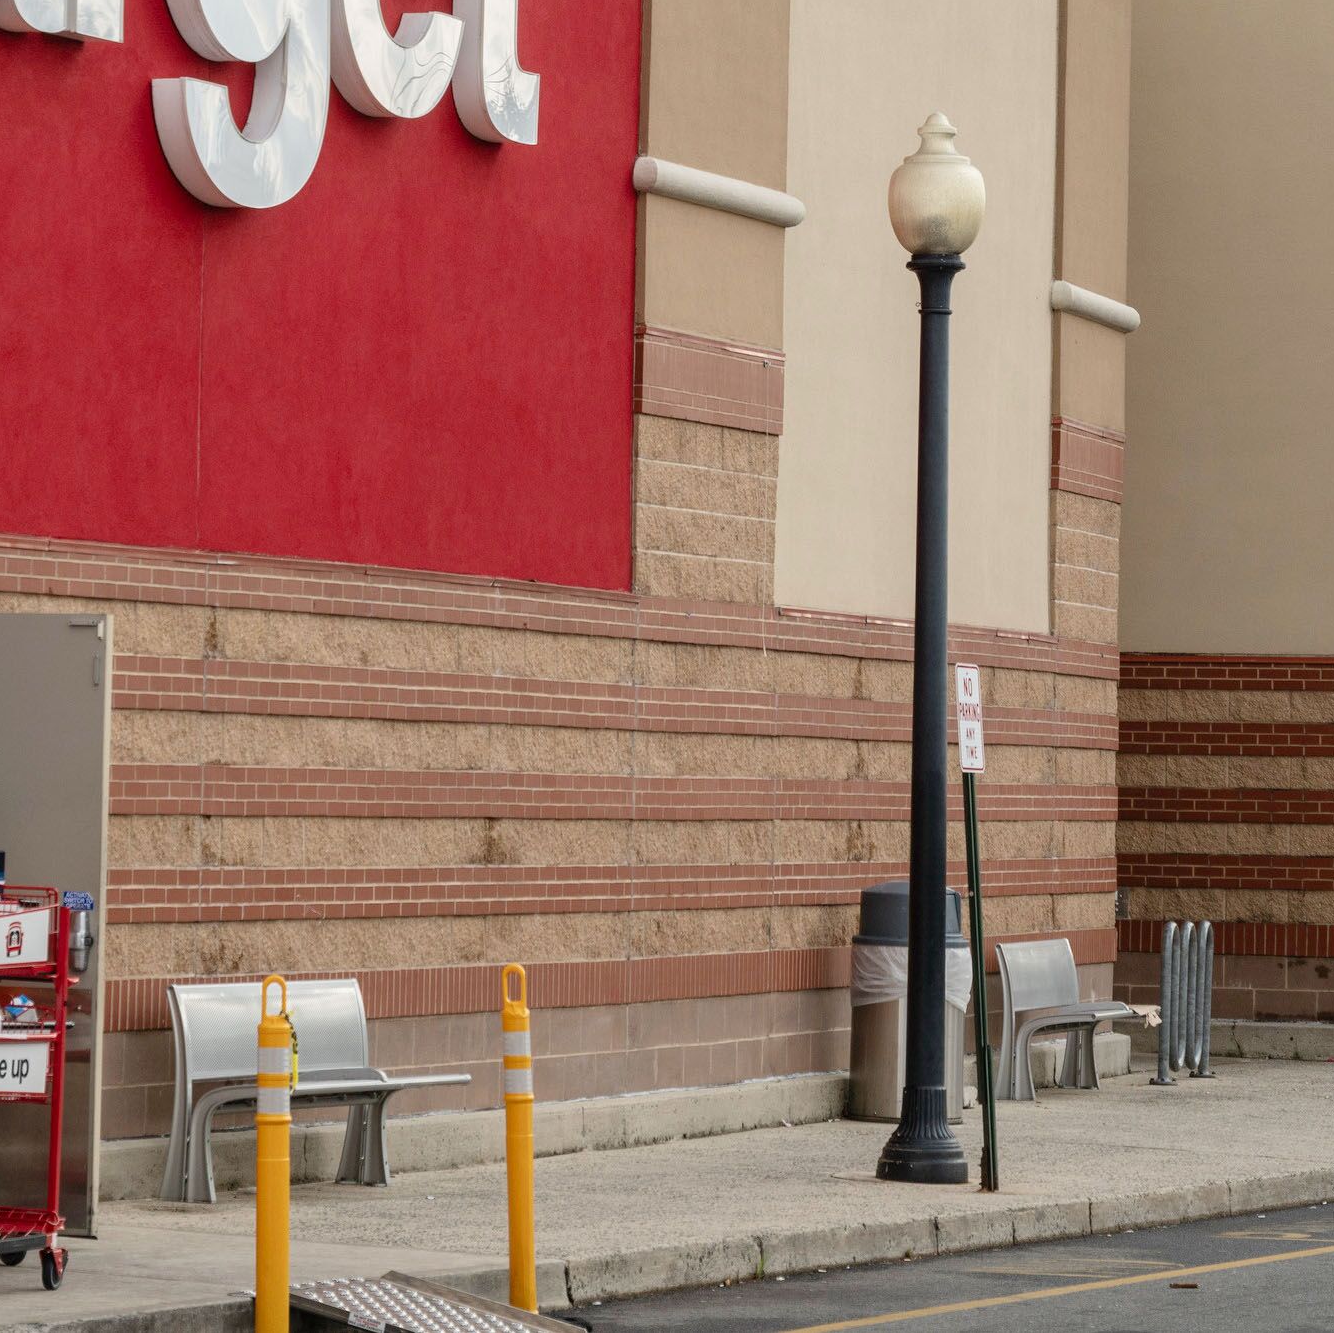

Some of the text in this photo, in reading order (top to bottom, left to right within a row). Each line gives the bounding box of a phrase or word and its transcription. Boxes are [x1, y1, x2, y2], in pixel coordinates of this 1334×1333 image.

[963, 677, 973, 697] NO
[959, 702, 980, 723] PARKING
[966, 728, 976, 741] ANY
[966, 745, 978, 760] TIME
[11, 1058, 29, 1084] up
